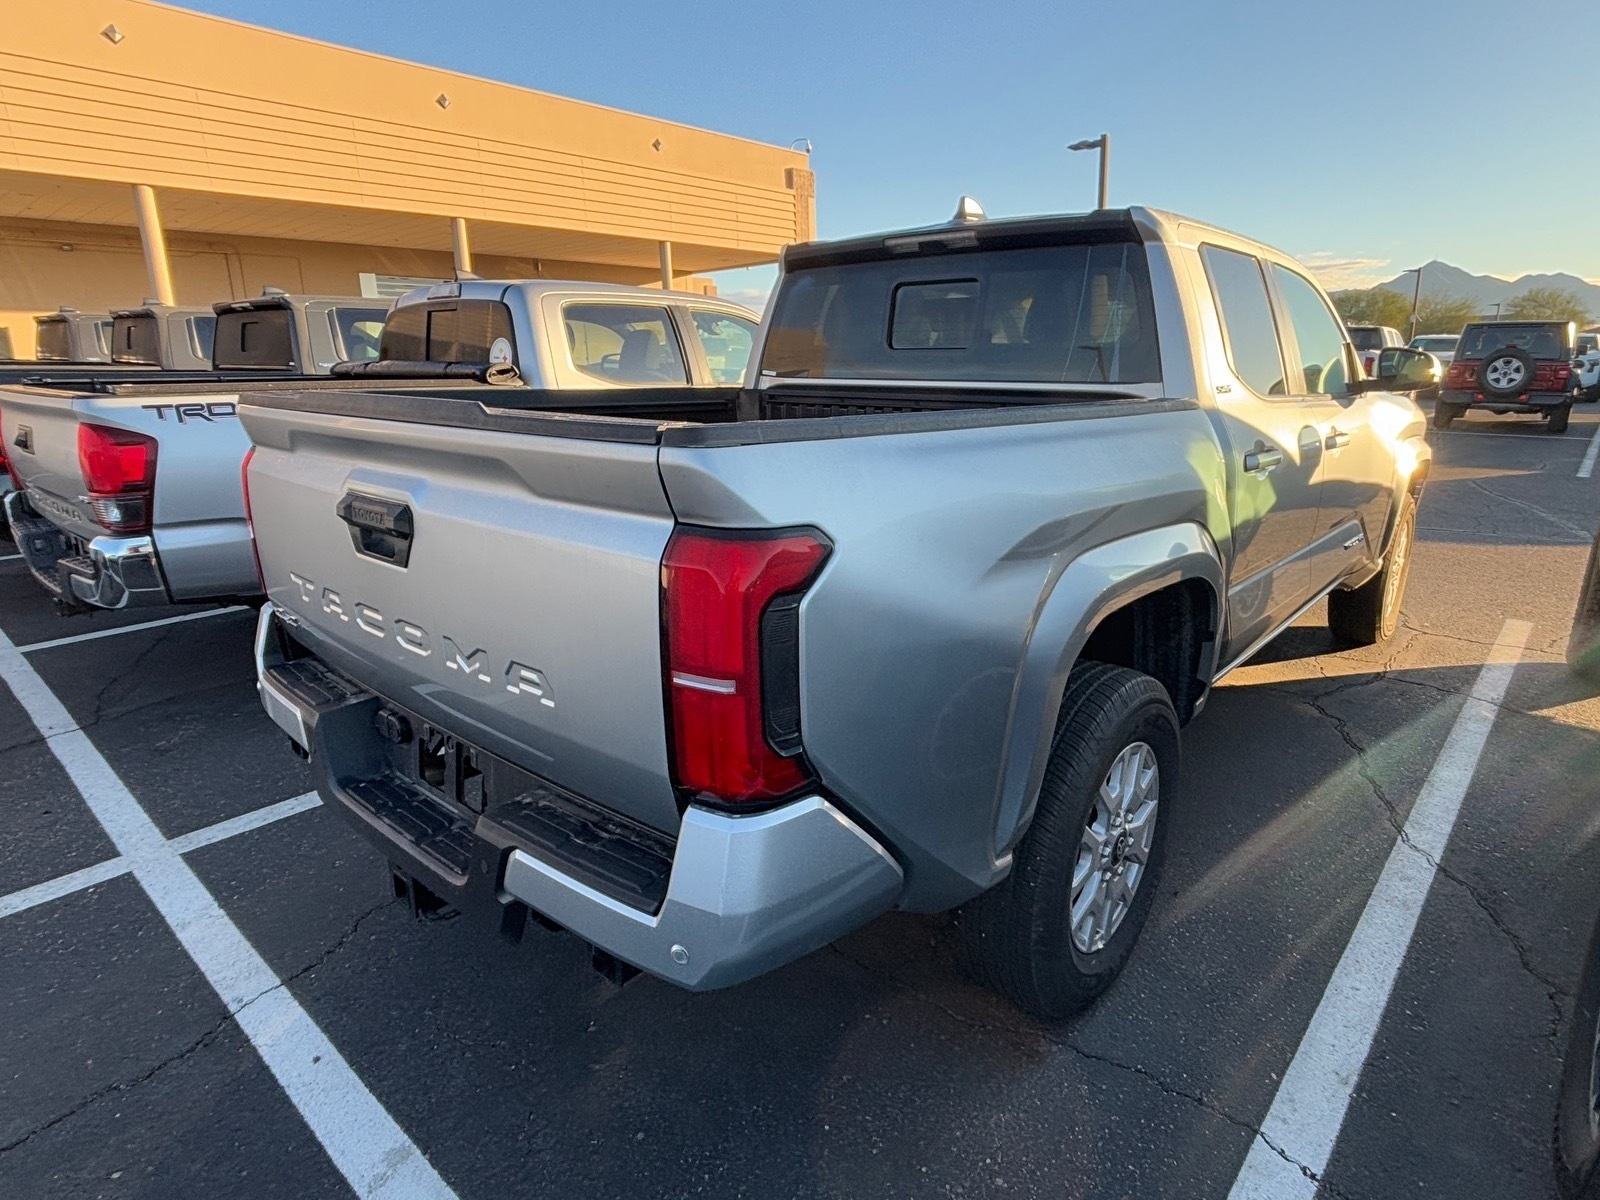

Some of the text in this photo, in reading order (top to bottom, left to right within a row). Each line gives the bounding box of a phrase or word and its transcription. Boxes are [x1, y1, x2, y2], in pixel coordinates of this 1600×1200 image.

[141, 402, 238, 425] TRD
[352, 506, 386, 526] TOYOTA
[289, 571, 556, 708] TACOMA
